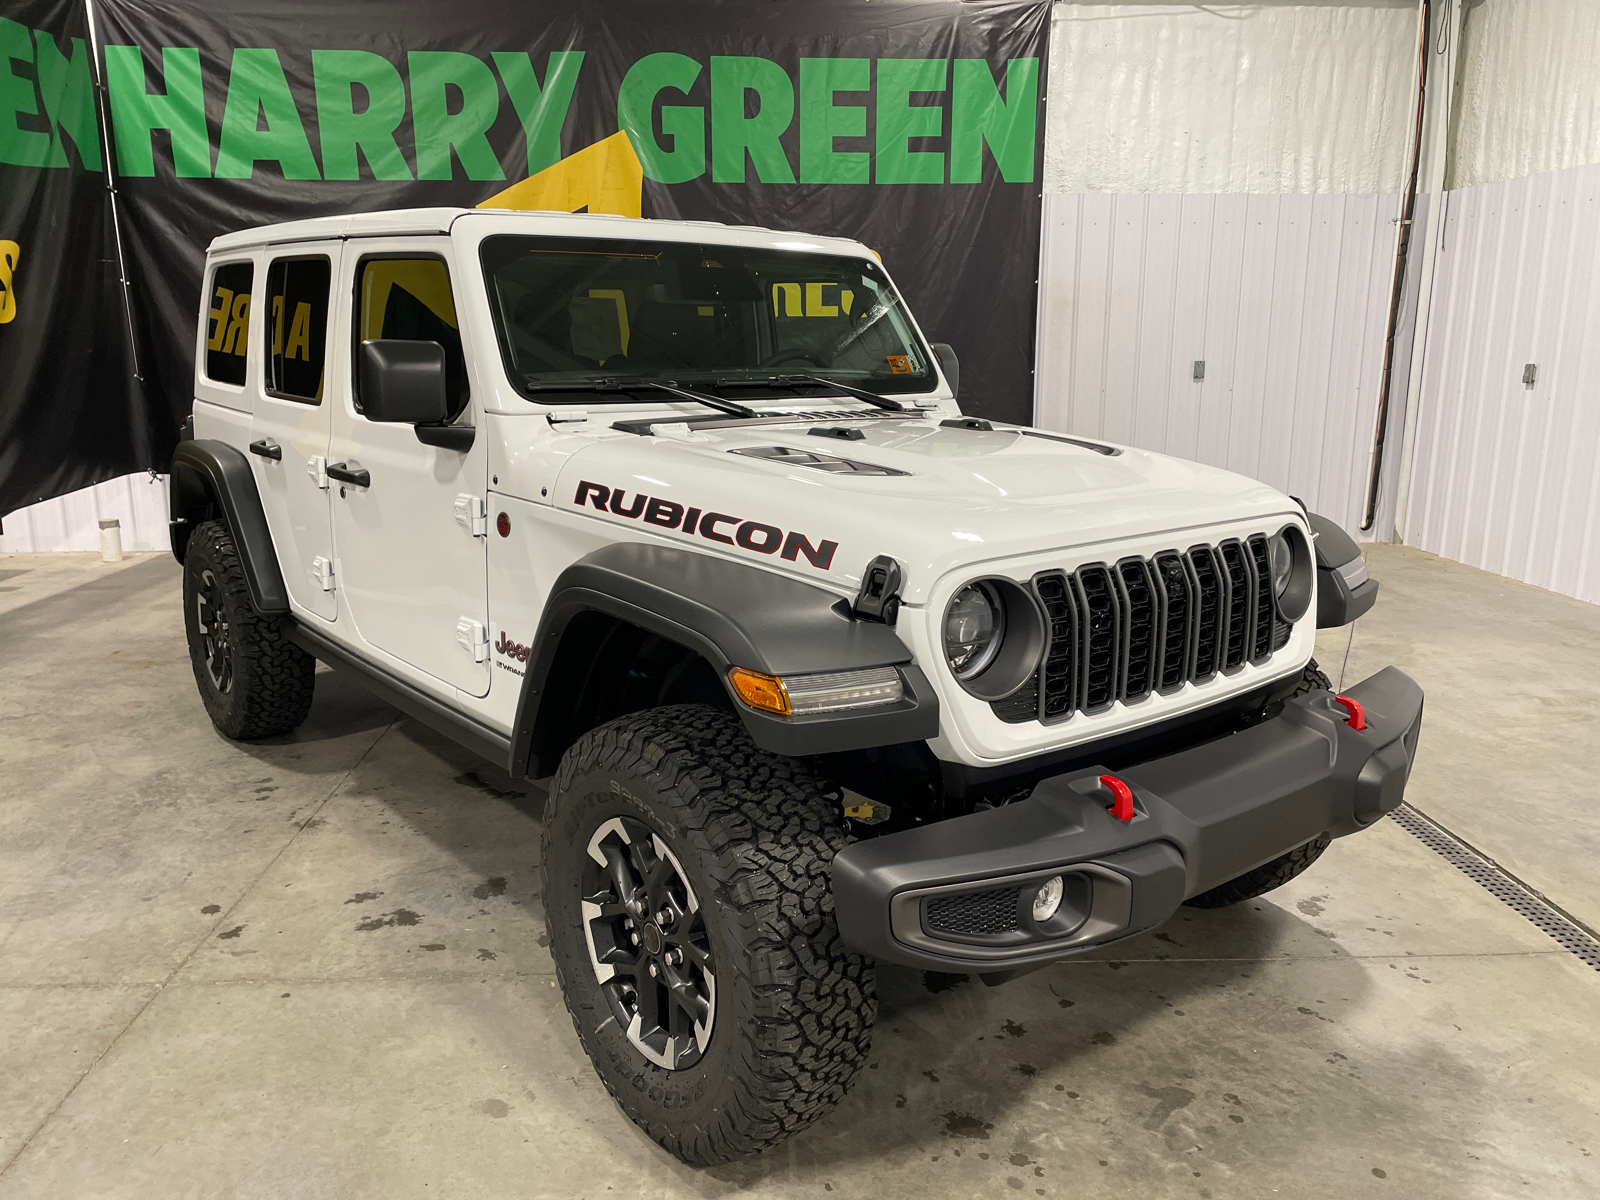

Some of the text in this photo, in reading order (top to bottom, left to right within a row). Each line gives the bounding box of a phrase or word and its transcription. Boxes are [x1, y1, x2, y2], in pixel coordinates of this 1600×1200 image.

[105, 45, 1039, 185] HARRY GREEN
[574, 480, 839, 570] RUBICON
